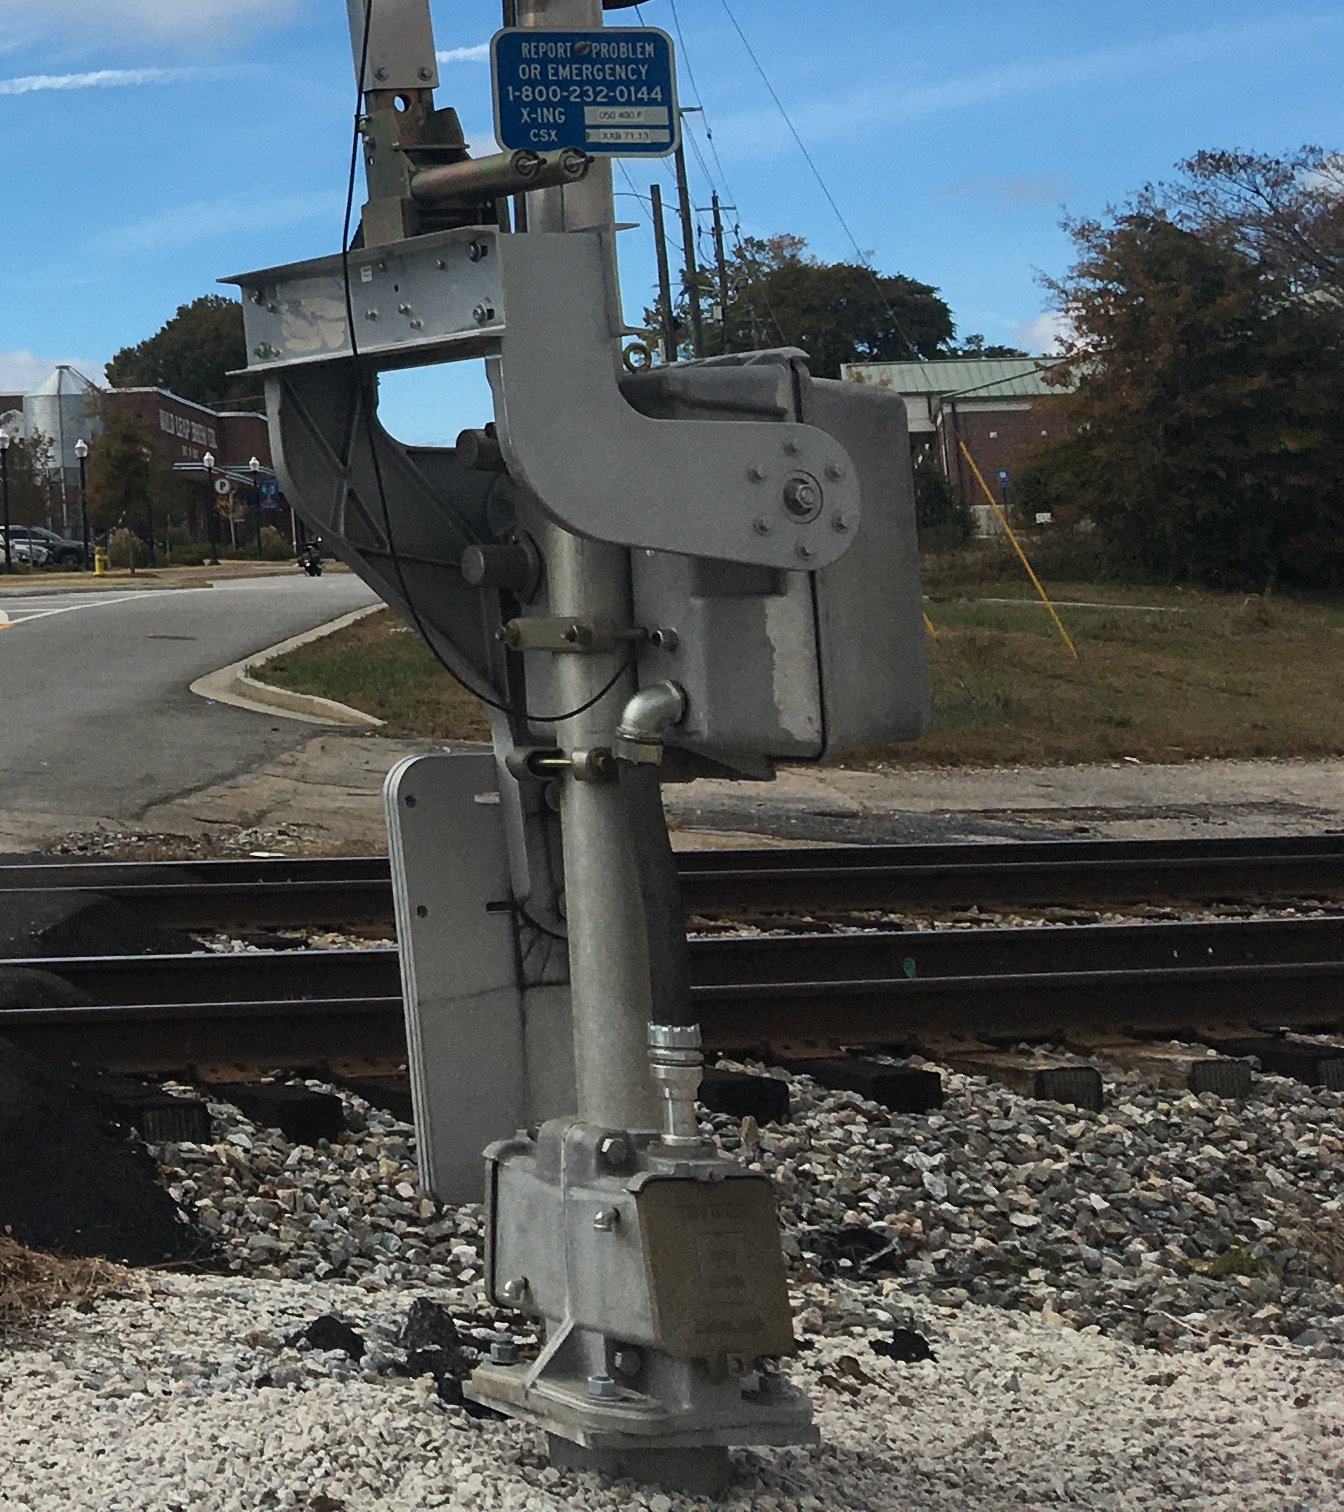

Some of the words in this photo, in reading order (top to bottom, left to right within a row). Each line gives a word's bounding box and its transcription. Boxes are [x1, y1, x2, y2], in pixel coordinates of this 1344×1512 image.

[521, 41, 572, 59] REPORT
[591, 41, 655, 59] PROBLEM
[518, 63, 541, 80] OR
[548, 63, 649, 80] EMERGENCY
[507, 85, 663, 102] 1-800-232-0144
[520, 107, 566, 124] X-ING
[529, 128, 558, 142] CSX
[219, 481, 226, 491] P
